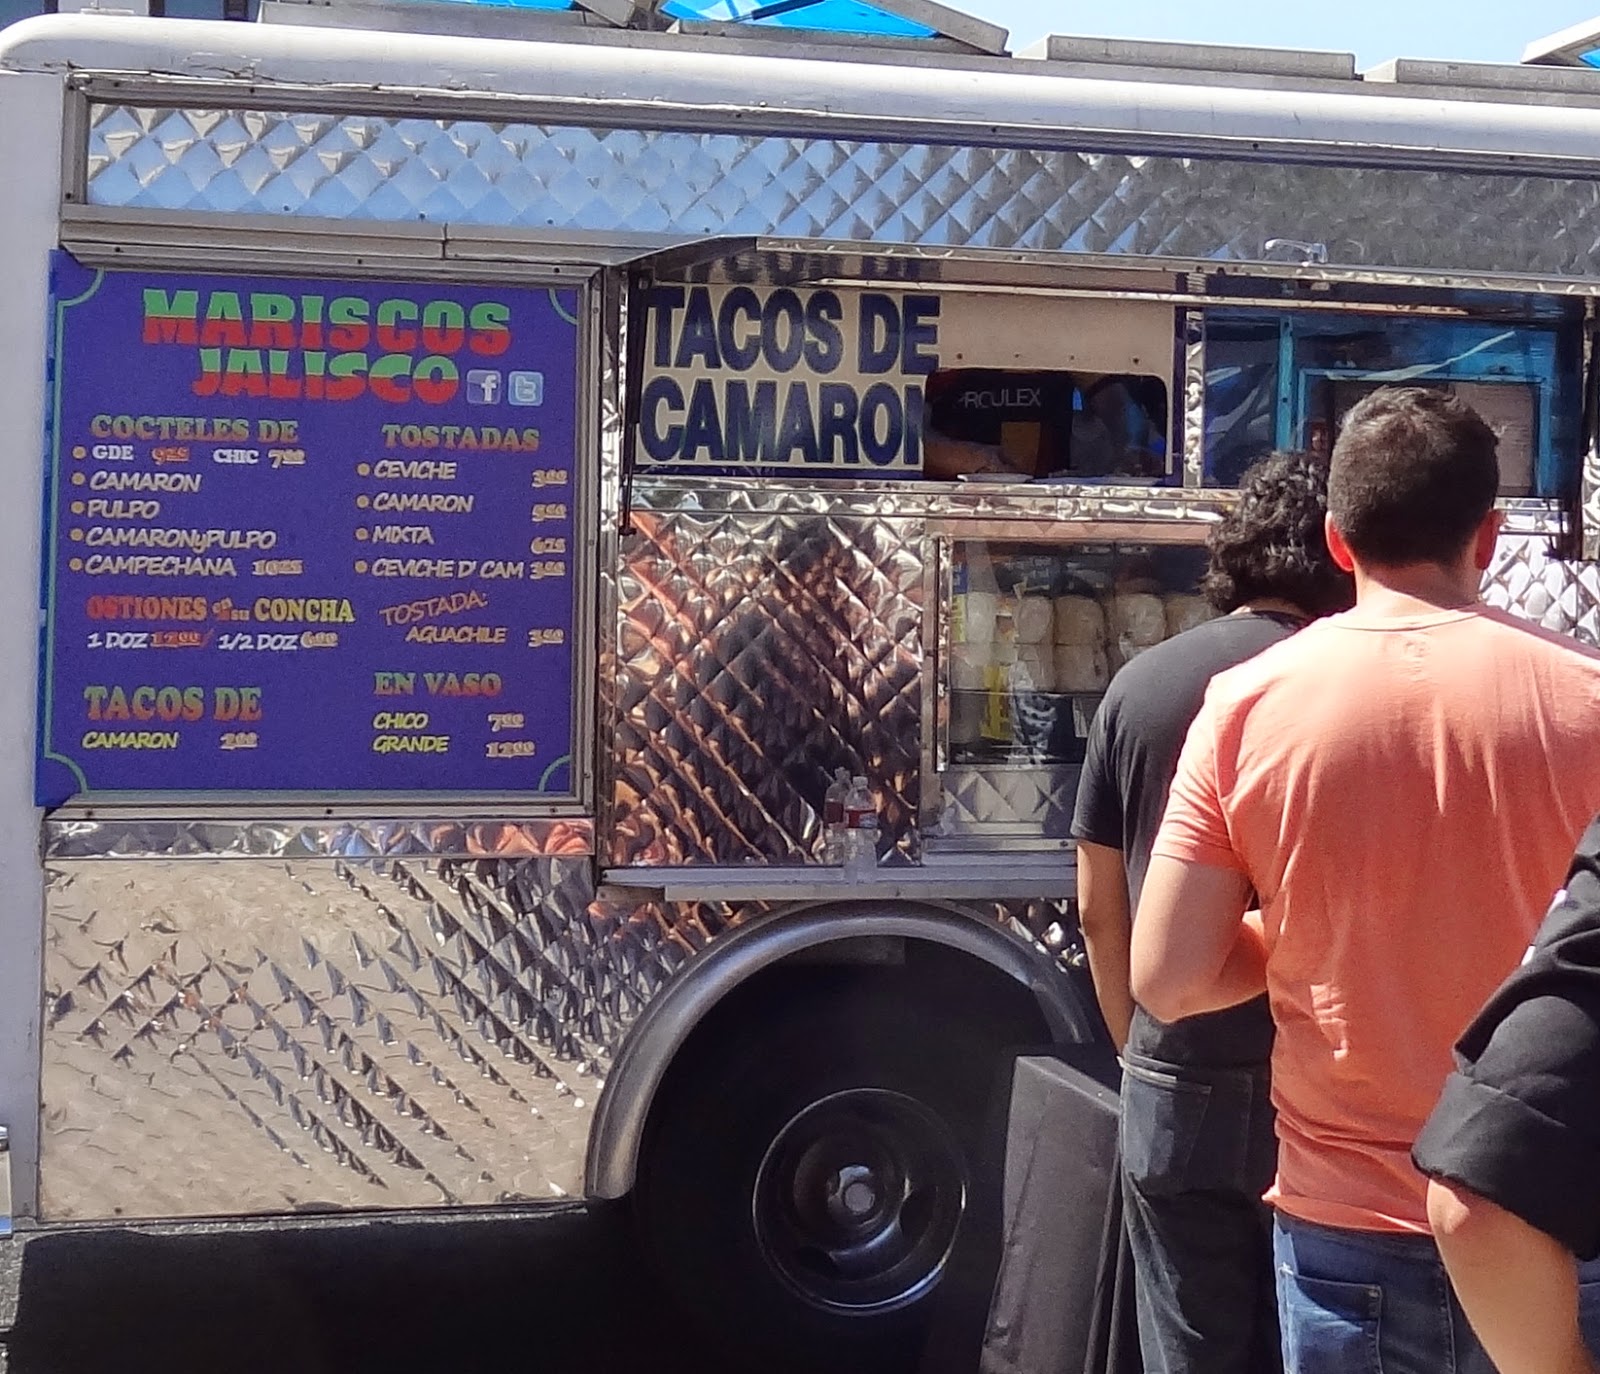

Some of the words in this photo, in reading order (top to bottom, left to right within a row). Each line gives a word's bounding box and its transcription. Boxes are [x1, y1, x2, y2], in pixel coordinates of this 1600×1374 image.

[143, 288, 512, 358] MARISCOS
[646, 286, 844, 374] TACOS
[858, 295, 940, 375] DE
[191, 348, 460, 405] JALISCO
[90, 414, 249, 441] COCTELES
[258, 419, 299, 443] DE
[381, 424, 540, 451] TOSTADAS
[92, 445, 135, 460] GDE
[212, 448, 260, 464] CHIC
[373, 459, 457, 480] CEVICHE
[89, 471, 203, 493] CAMARON
[87, 499, 160, 519] PULPO
[371, 491, 475, 512] CAMARON
[371, 525, 435, 545] MIXTA
[84, 554, 238, 577] CAMPECHANA
[371, 558, 454, 578] CEVICHE
[253, 597, 356, 623] CONCHA
[87, 632, 103, 648] 1
[105, 631, 149, 649] DOZ
[218, 632, 255, 650] 1/2
[256, 634, 299, 650] DOZ
[404, 625, 509, 644] AGUACHILE
[373, 671, 417, 695] EN
[423, 672, 502, 697] VASO
[84, 686, 205, 722] TACOS
[213, 686, 263, 722] DE
[372, 712, 430, 730] CHICO
[82, 731, 179, 749] CAMARON
[372, 735, 451, 754] GRANDE
